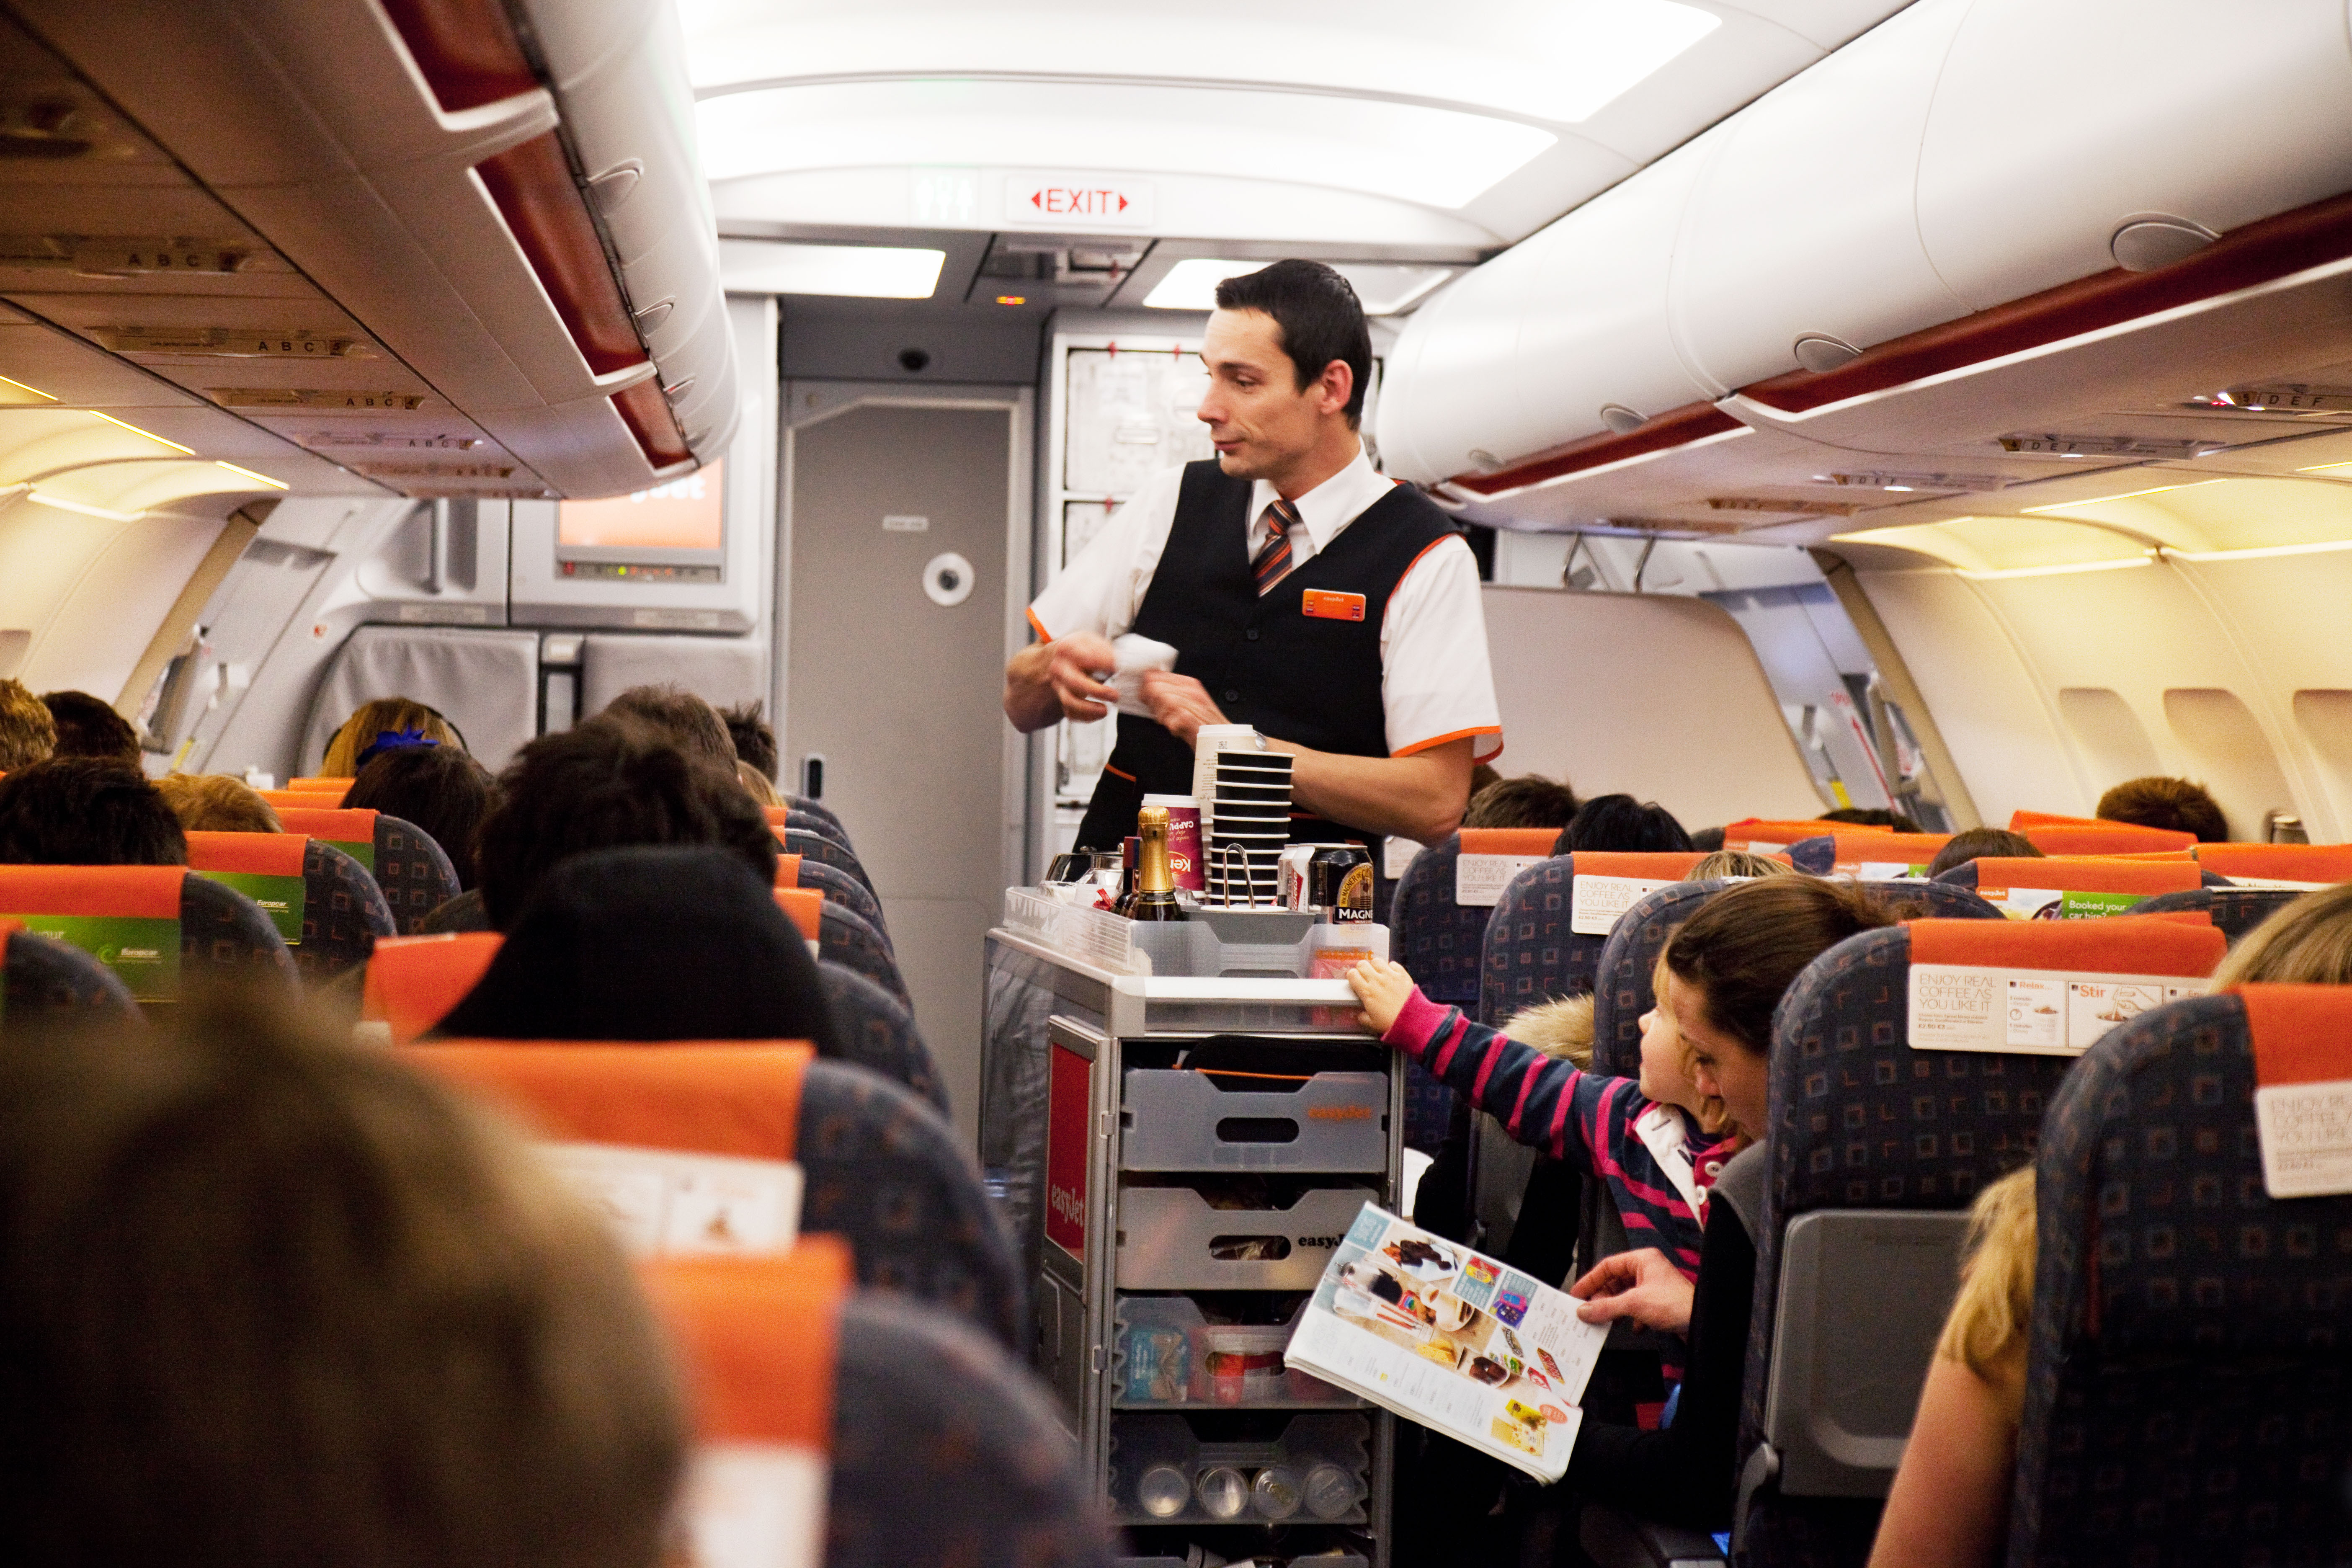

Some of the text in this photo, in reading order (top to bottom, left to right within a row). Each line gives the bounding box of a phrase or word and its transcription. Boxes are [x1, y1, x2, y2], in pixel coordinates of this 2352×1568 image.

[1047, 189, 1112, 214] EXIT
[258, 341, 268, 351] A
[281, 342, 291, 351] B
[304, 342, 314, 352] C
[2269, 395, 2280, 404] D
[2291, 395, 2300, 405] E
[2313, 397, 2322, 406] F
[1342, 875, 1358, 897] MAGNER
[1580, 881, 1633, 892] ENJOY REAL
[1580, 890, 1616, 899] COFFEE
[1580, 898, 1599, 907] YOU
[1602, 900, 1619, 908] LIKE
[2069, 900, 2127, 912] Booked your
[1920, 974, 1996, 988] ENJOY REAL
[1920, 986, 1992, 1000] COFFEE AS
[2080, 985, 2106, 998] Stir
[1919, 998, 1992, 1011] YOU LIKE IT
[1308, 1106, 1372, 1120] easyJet
[1052, 1184, 1084, 1228] easyJet
